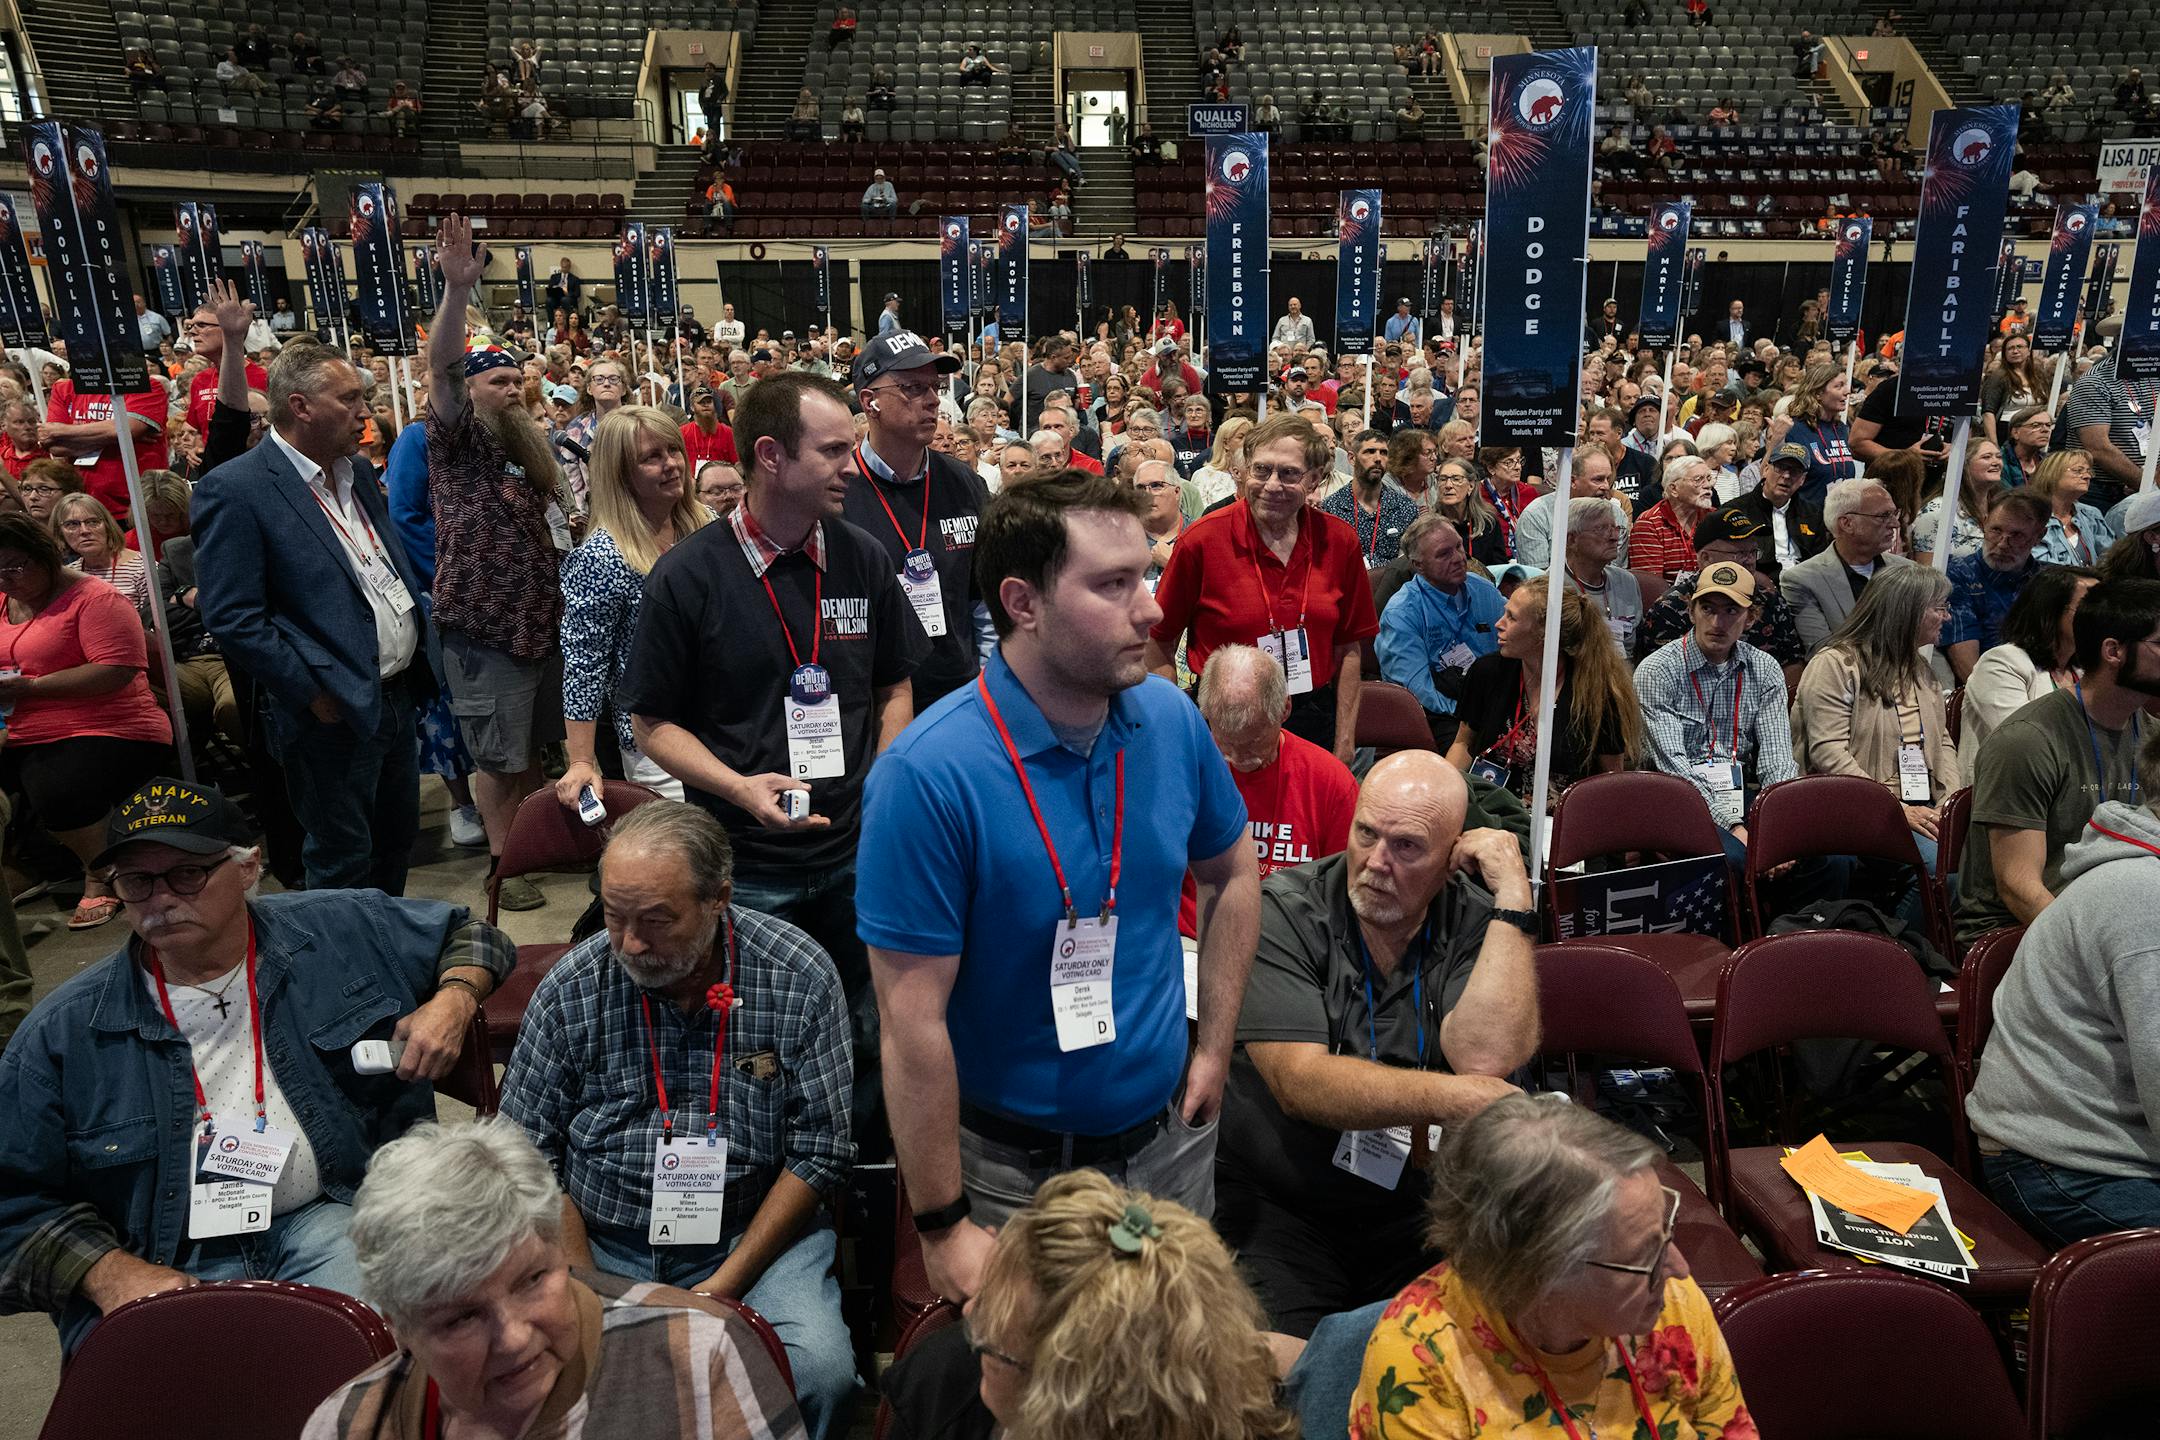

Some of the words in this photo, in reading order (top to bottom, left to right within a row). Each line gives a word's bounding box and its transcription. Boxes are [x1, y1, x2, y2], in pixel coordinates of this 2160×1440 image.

[1517, 70, 1566, 91] MINNESOTA
[1895, 78, 1915, 108] 19
[1193, 109, 1243, 123] QUALLS
[1514, 112, 1552, 132] REPUBLICAN
[1549, 111, 1567, 129] PARTY
[1199, 121, 1237, 129] NICHOLSON
[1950, 121, 1994, 141] MINNESOTA
[2102, 148, 2134, 167] LISA
[10, 244, 33, 314] LINCOLN
[53, 218, 84, 336] DOUGLAS
[96, 219, 127, 336] DOUGLAS
[368, 242, 387, 318] KITTSON
[631, 256, 640, 309] MORRISON
[660, 264, 669, 302] NORMAN
[951, 259, 961, 304] NOBLES
[1008, 260, 1018, 304] MOWER
[1232, 222, 1243, 336] FREEBORN
[1351, 245, 1363, 318] HOUSTON
[1525, 216, 1545, 335] DODGE
[1938, 205, 1970, 357] FARIBAULT
[1655, 256, 1670, 314] MARTIN
[1841, 258, 1855, 314] NICOLLET
[2052, 253, 2073, 319] JACKSON
[720, 326, 738, 337] USA
[1216, 366, 1237, 374] Republican
[1237, 366, 1247, 374] Party
[1909, 385, 1938, 394] Republican
[1938, 384, 1953, 394] Party
[1953, 384, 1960, 392] of
[1960, 384, 1969, 392] MN
[1916, 392, 1945, 400] Convention
[1946, 392, 1959, 400] 2026
[1923, 400, 1942, 408] Duluth,
[1495, 407, 1527, 418] Republican
[1528, 408, 1544, 418] Party
[1545, 408, 1552, 416] of
[1553, 408, 1562, 416] MN
[1503, 418, 1535, 426] Convention
[1537, 418, 1552, 426] 2026
[1511, 428, 1532, 437] Duluth,
[1533, 428, 1543, 436] MN
[906, 552, 932, 568] DEMUTH
[915, 561, 934, 572] WILSON
[820, 597, 869, 620] DEMUTH
[835, 617, 868, 635] WILSON
[931, 624, 939, 632] D
[794, 671, 827, 687] DEMUTH
[803, 682, 828, 694] WILSON
[789, 722, 822, 731] SATURDAY
[822, 720, 839, 728] ONLY
[799, 764, 808, 774] D
[151, 785, 203, 806] NAVY
[1905, 789, 1911, 797] A
[128, 814, 187, 832] VETERAN
[1054, 960, 1092, 973] SATURDAY
[1091, 958, 1110, 968] ONLY
[1061, 969, 1085, 980] VOTING
[1085, 968, 1102, 977] CARD
[1074, 985, 1091, 995] Derek
[1097, 1020, 1107, 1035] D
[209, 1153, 255, 1169] SATURDAY
[255, 1162, 279, 1174] ONLY
[1341, 1150, 1352, 1164] A
[216, 1163, 245, 1174] VOTING
[245, 1168, 266, 1178] CARD
[656, 1173, 699, 1181] SATURDAY
[700, 1173, 721, 1181] ONLY
[218, 1189, 245, 1197] McDonald
[220, 1181, 244, 1190] James
[682, 1192, 696, 1200] Ken
[218, 1202, 243, 1210] Delegate
[247, 1210, 260, 1224] D
[658, 1224, 670, 1237] A
[1844, 1224, 1880, 1236] QUALLS
[1876, 1234, 1916, 1248] VOTE
[1924, 1234, 1940, 1243] FOR
[1923, 1262, 1957, 1277] JOIN
